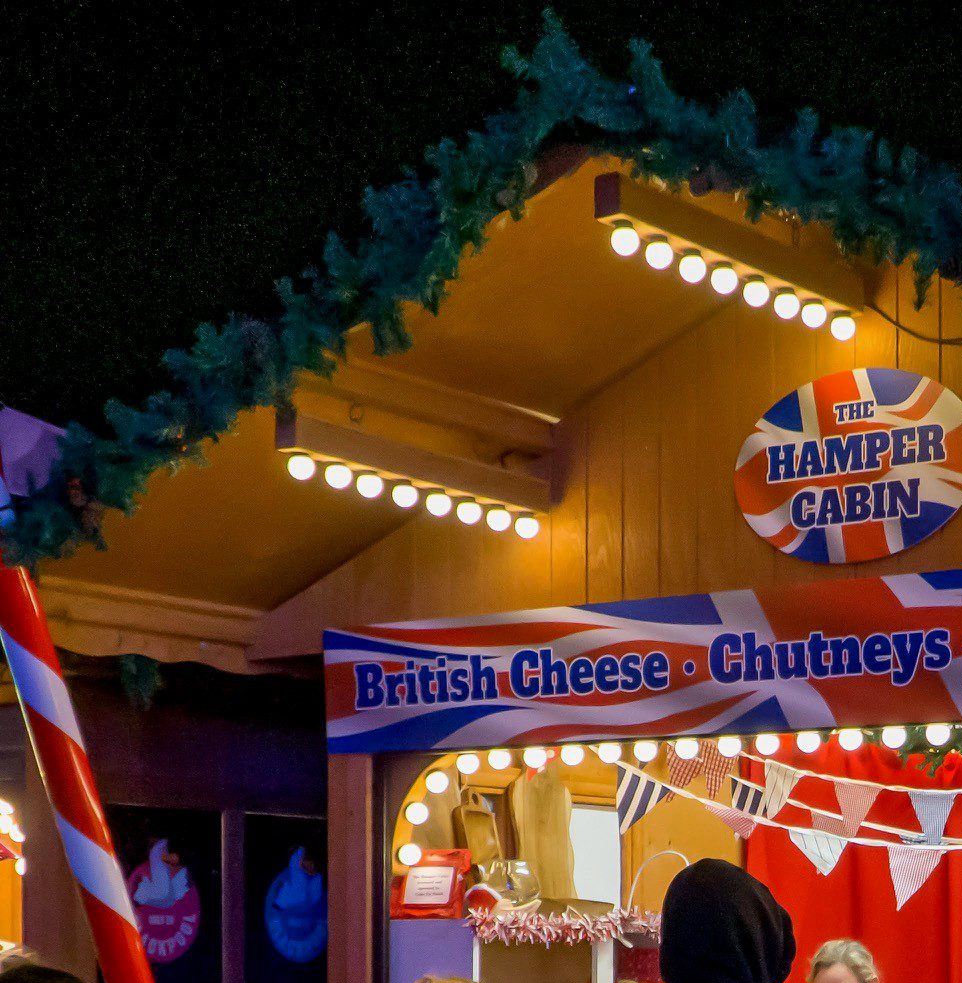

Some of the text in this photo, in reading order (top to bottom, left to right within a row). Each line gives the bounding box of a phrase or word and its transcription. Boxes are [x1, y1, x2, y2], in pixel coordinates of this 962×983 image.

[834, 401, 875, 423] THE
[767, 424, 946, 483] HAMPER
[791, 477, 921, 530] CABIN
[355, 656, 499, 710] British
[511, 649, 670, 698] Cheese
[708, 629, 952, 686] Chutneys
